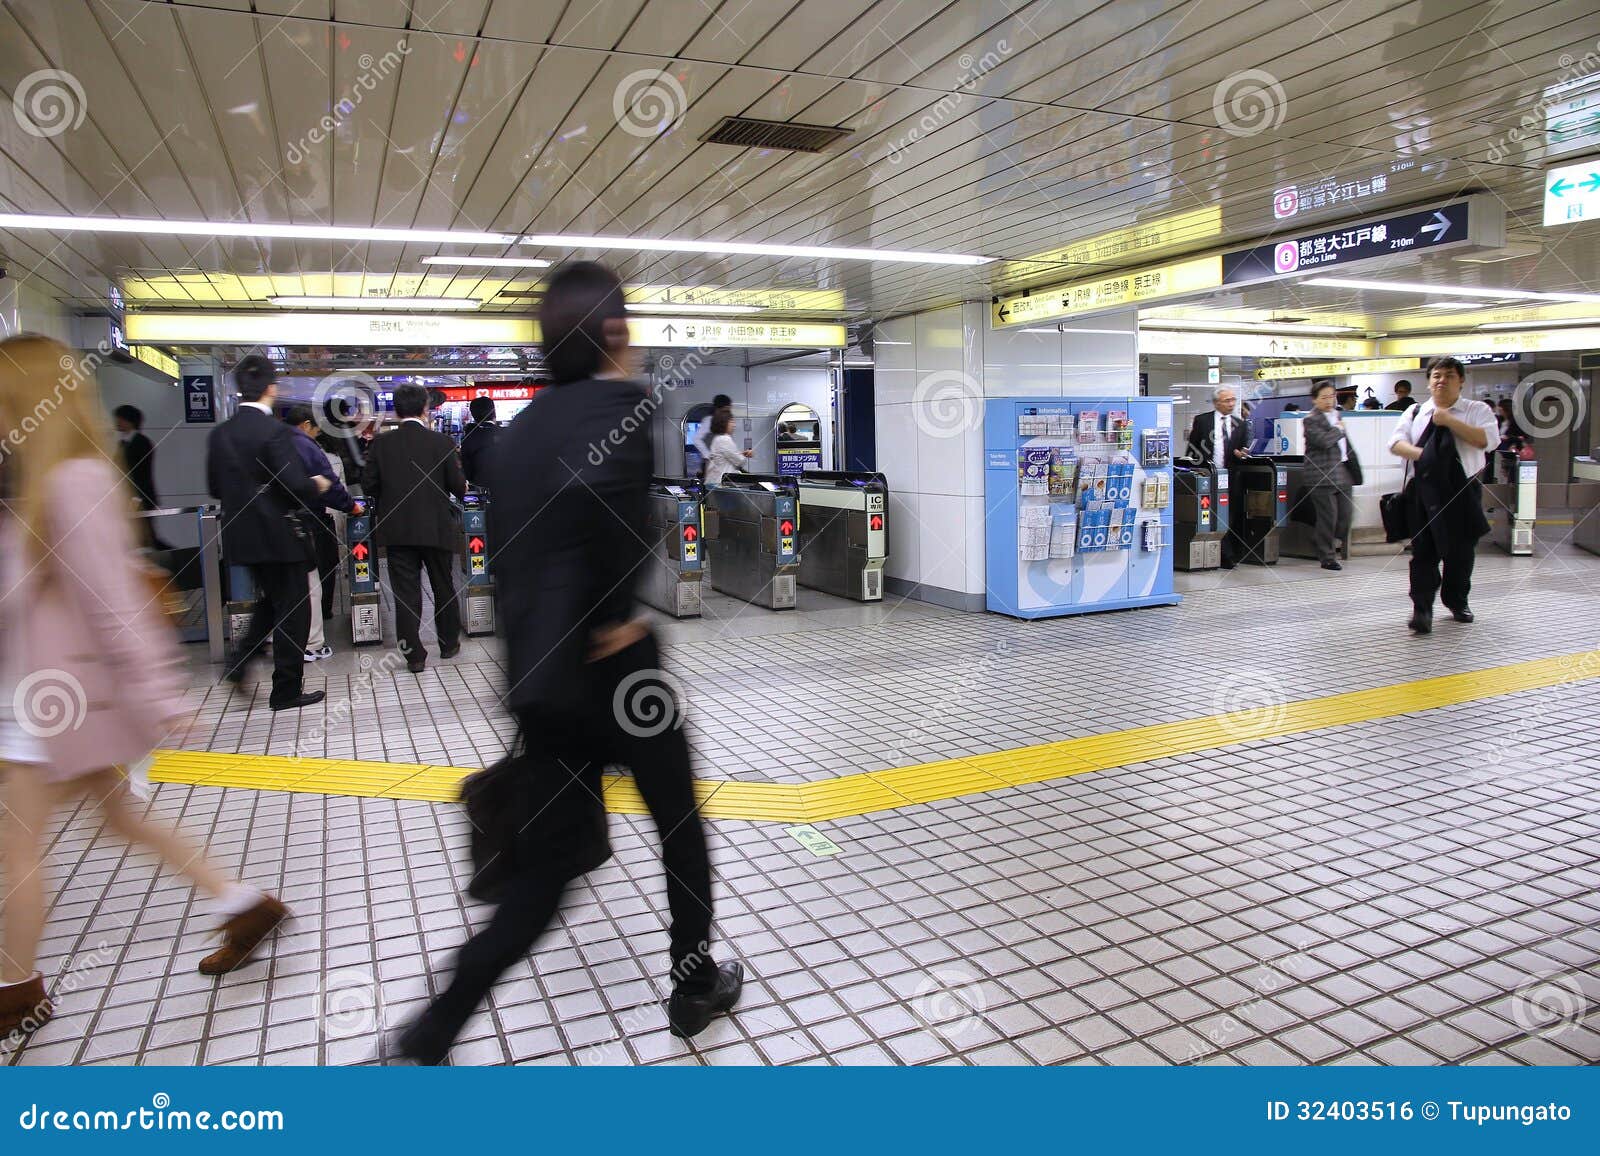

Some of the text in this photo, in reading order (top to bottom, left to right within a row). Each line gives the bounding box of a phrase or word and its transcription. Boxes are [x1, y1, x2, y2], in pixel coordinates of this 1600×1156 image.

[1300, 224, 1387, 258] 都営大江戸線
[1391, 236, 1414, 249] 210m
[1300, 252, 1337, 266] Oedo Line
[728, 326, 764, 337] 小田急線
[769, 327, 797, 337] 京王線
[871, 496, 882, 504] IC
